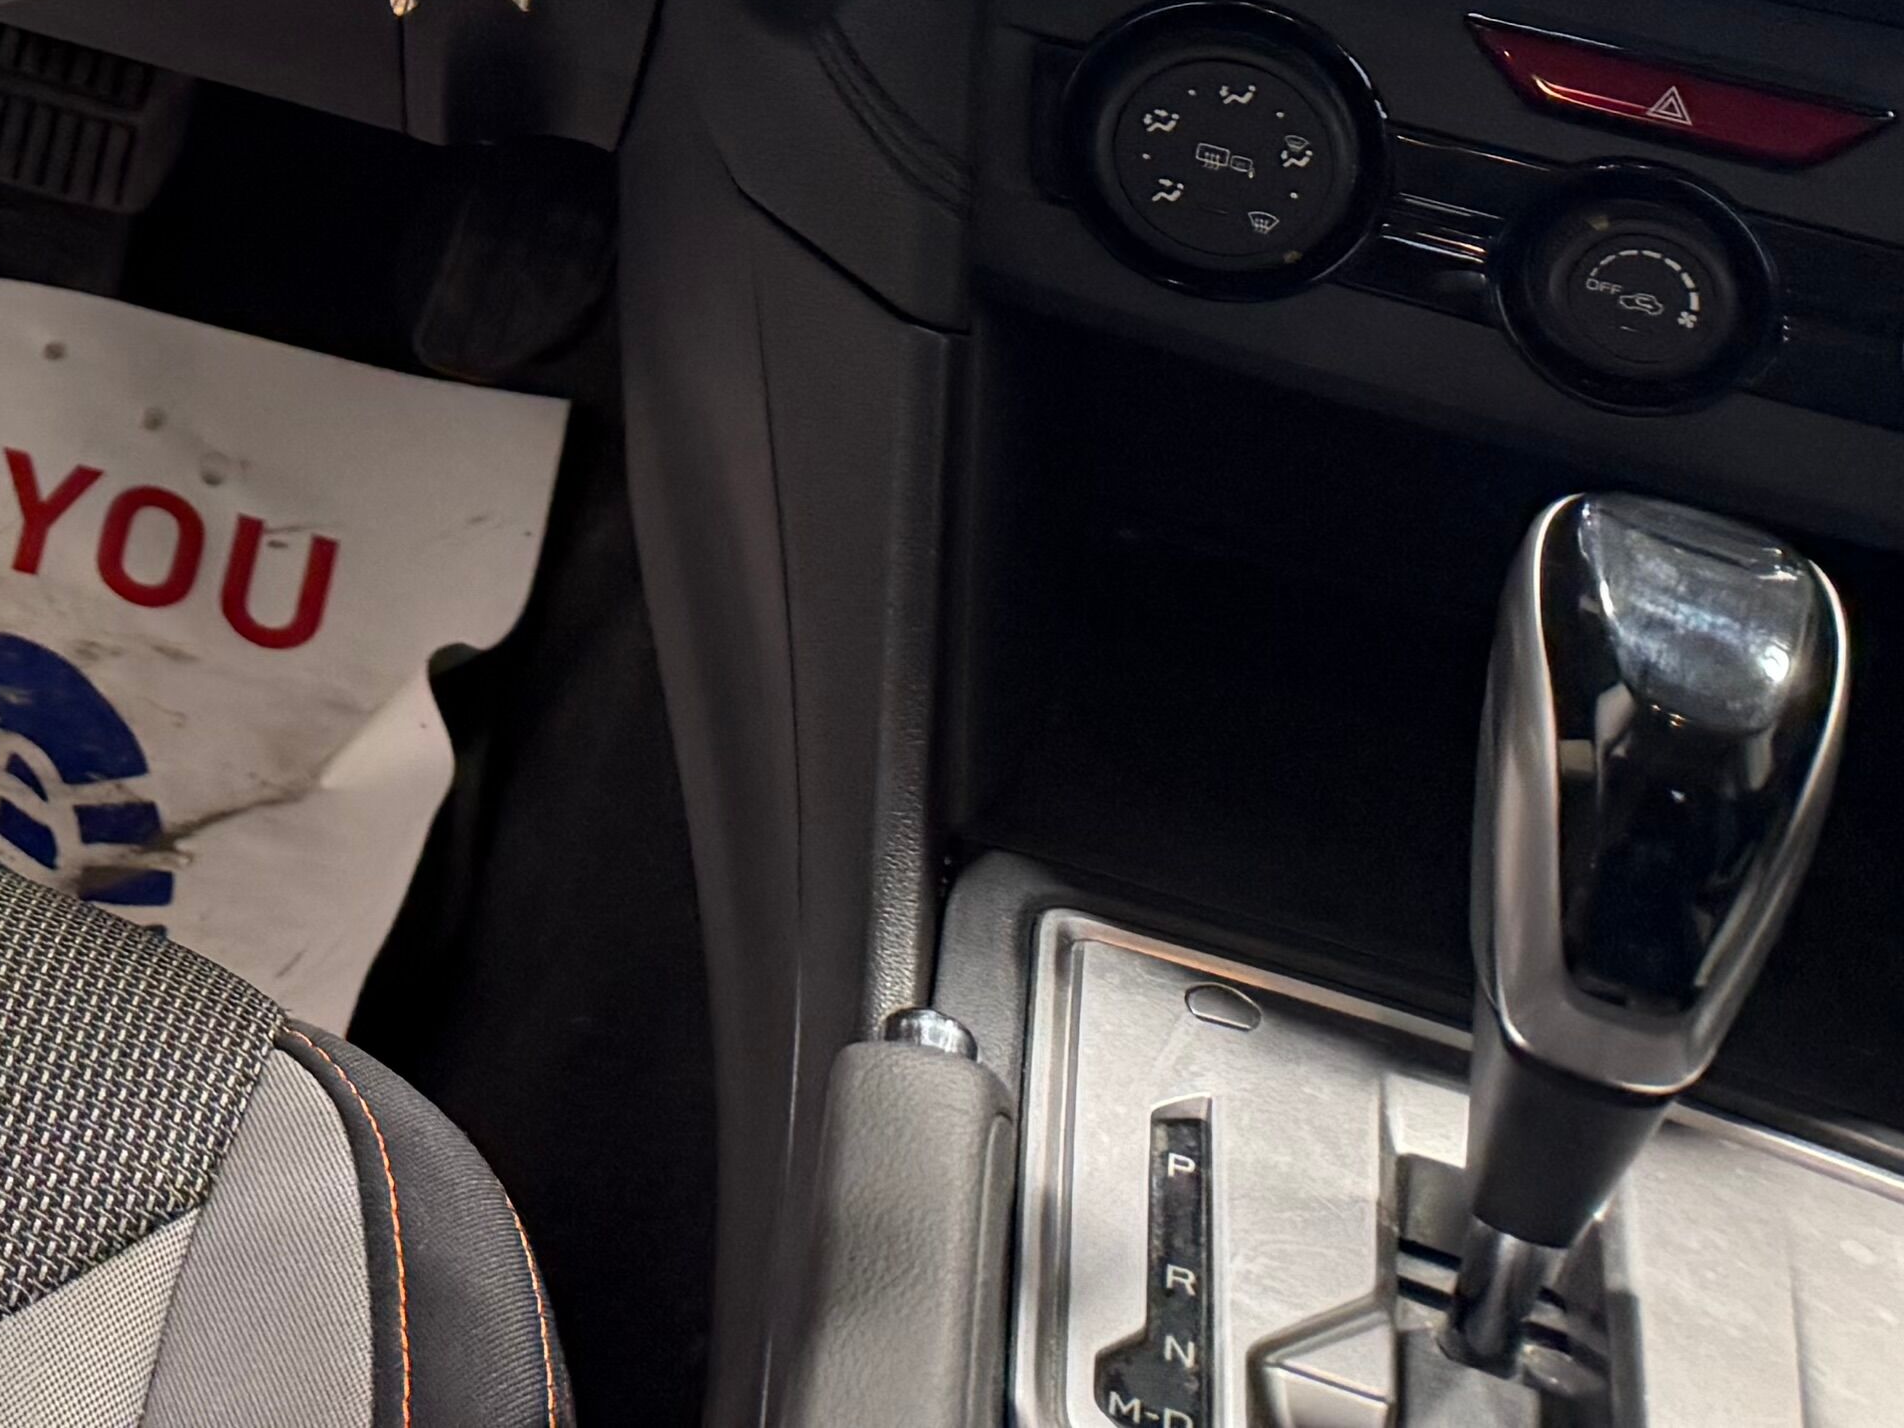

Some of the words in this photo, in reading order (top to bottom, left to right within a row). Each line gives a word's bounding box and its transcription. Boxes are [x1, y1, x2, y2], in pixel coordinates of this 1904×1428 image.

[1585, 278, 1622, 295] OFF
[2, 445, 339, 651] YOU
[1166, 1152, 1197, 1180] P
[1165, 1264, 1197, 1297] R
[1163, 1334, 1196, 1368] N
